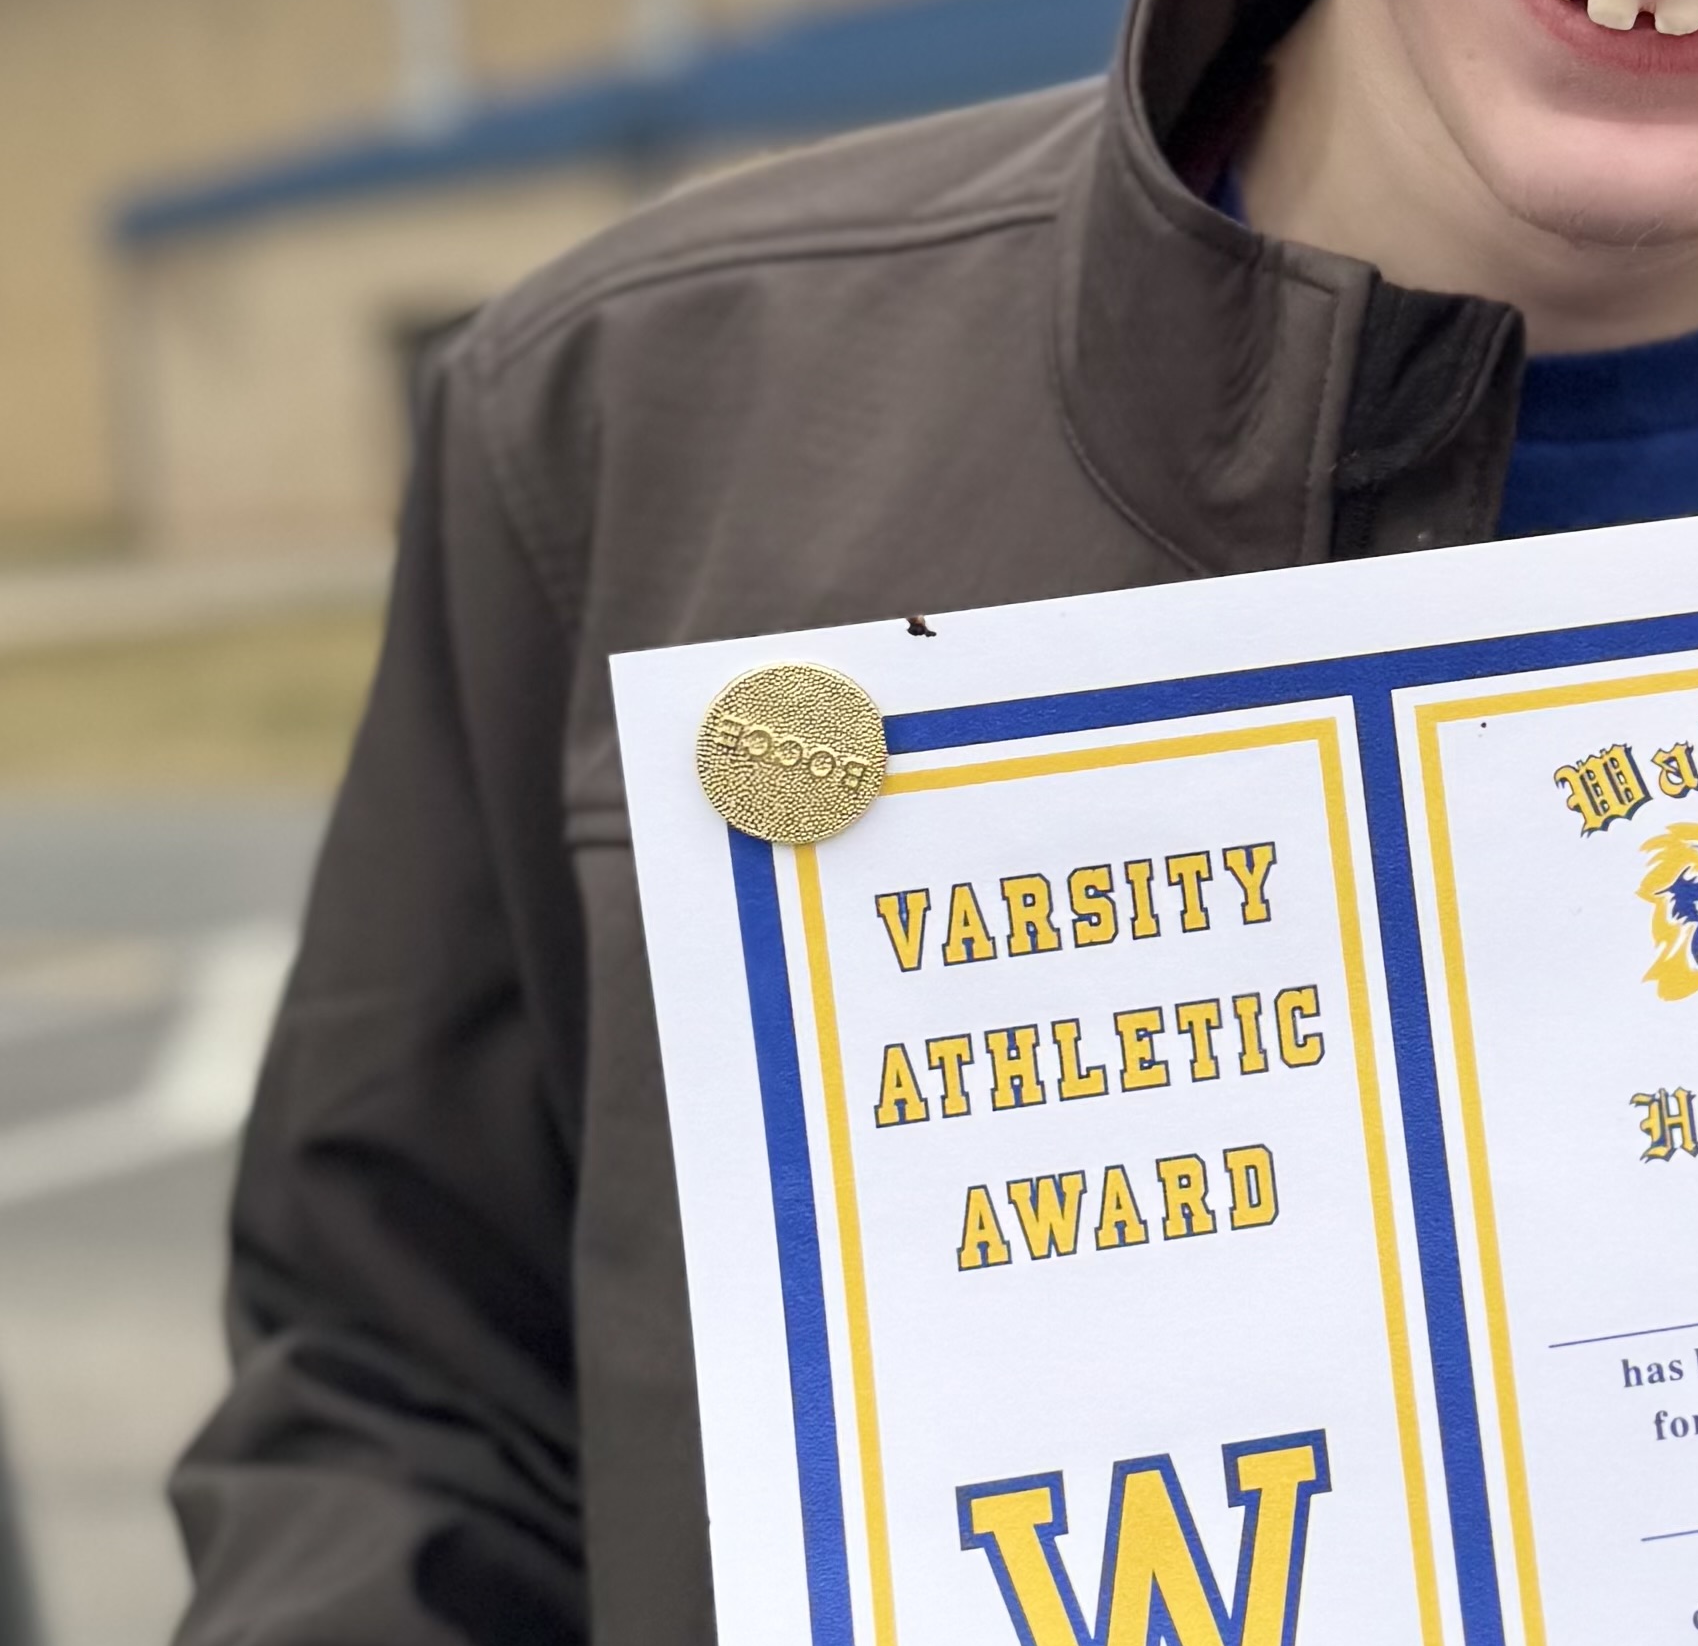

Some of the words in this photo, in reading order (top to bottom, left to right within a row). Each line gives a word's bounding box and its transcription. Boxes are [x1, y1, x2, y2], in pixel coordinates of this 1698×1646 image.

[714, 717, 869, 792] BOCCE
[876, 842, 1276, 971] VARSITY
[876, 985, 1325, 1128] ATHLETIC
[957, 1144, 1279, 1271] AWARD
[1621, 1358, 1684, 1388] has
